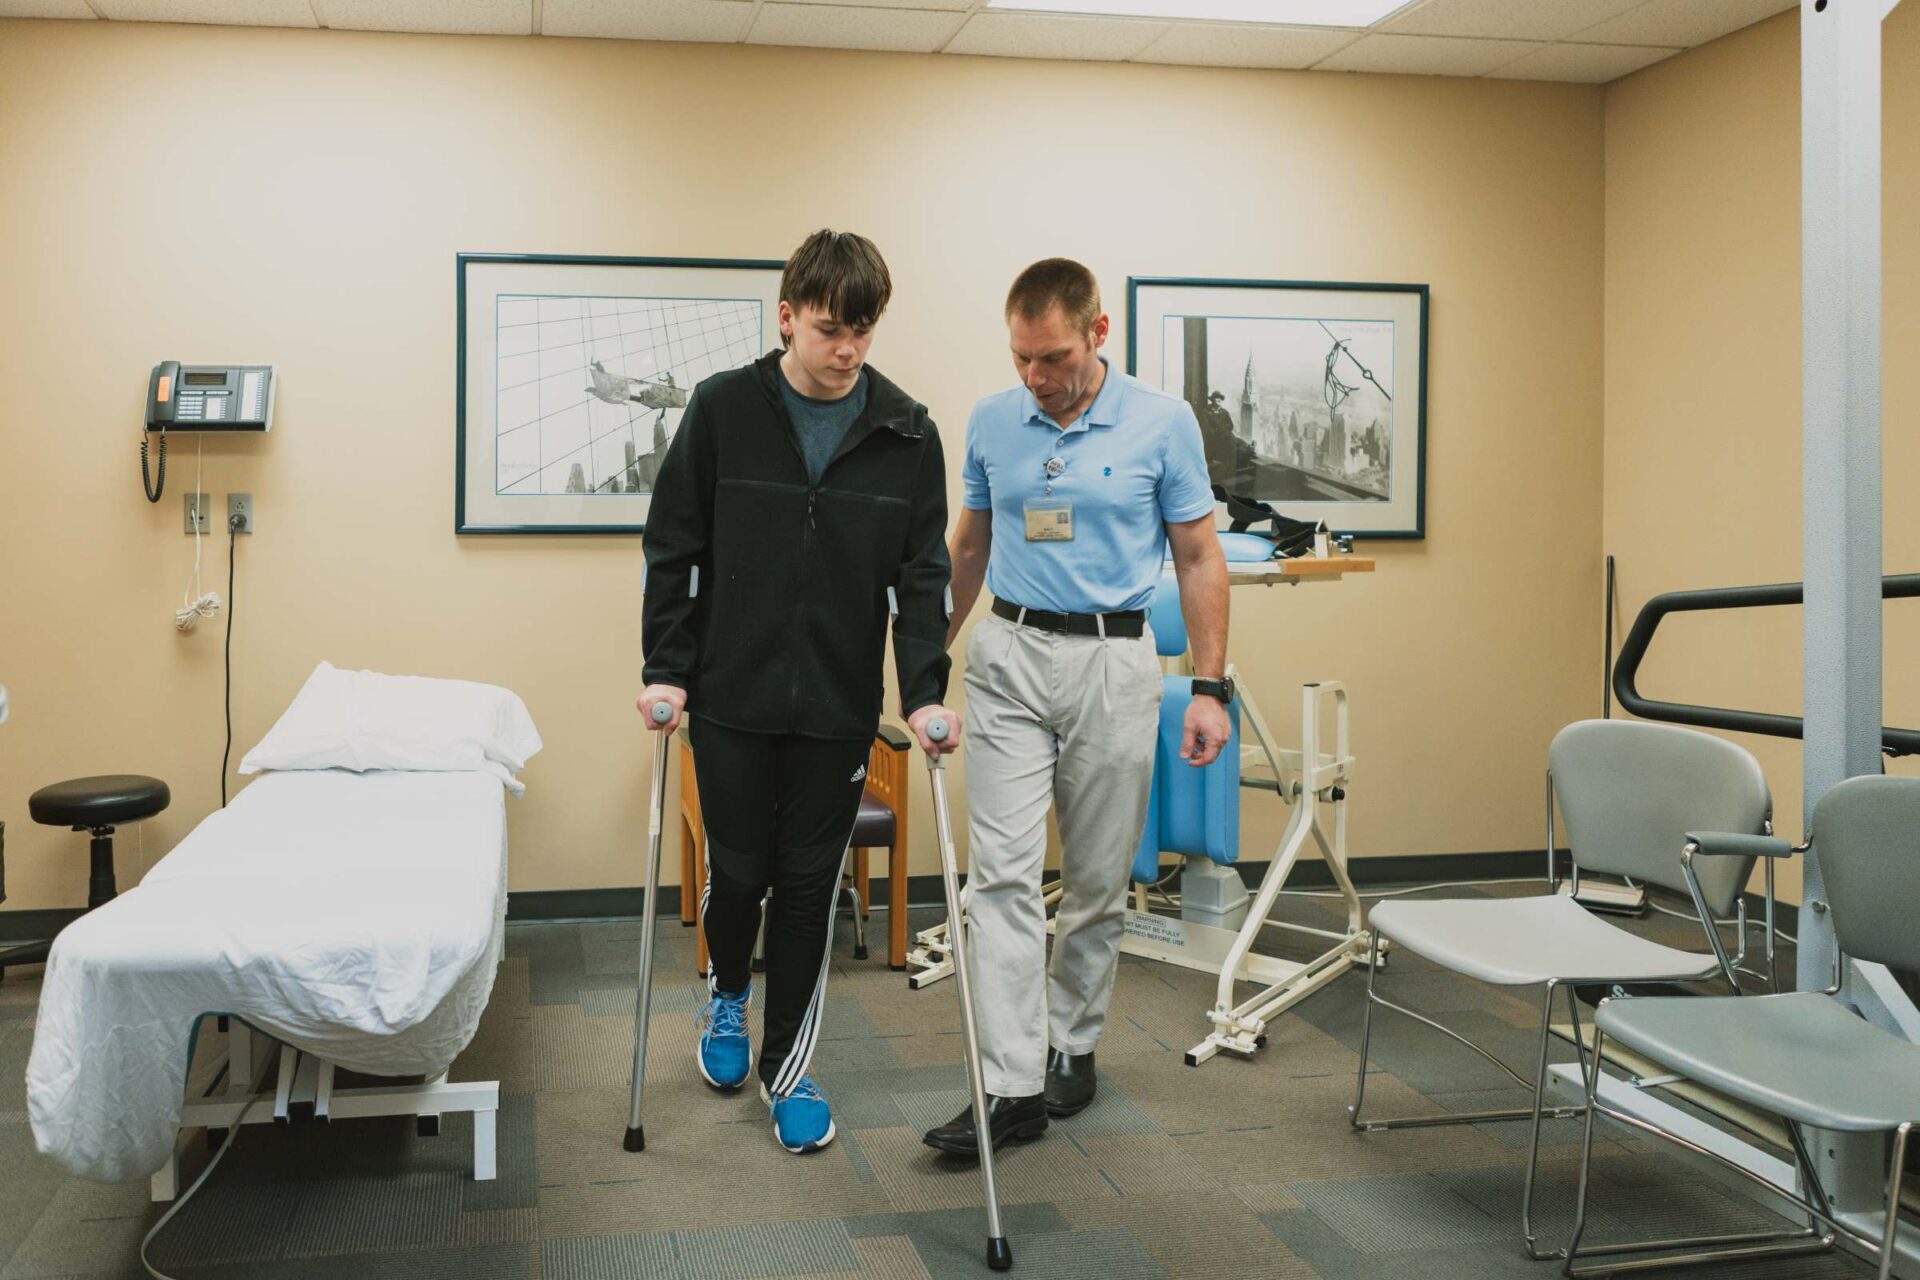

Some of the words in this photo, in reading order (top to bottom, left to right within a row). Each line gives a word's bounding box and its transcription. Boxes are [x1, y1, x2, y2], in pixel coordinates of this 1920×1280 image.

[1125, 928, 1146, 937] WERED
[1146, 933, 1171, 943] BEFORE
[1135, 922, 1152, 931] MUST
[1161, 929, 1180, 937] FULLY
